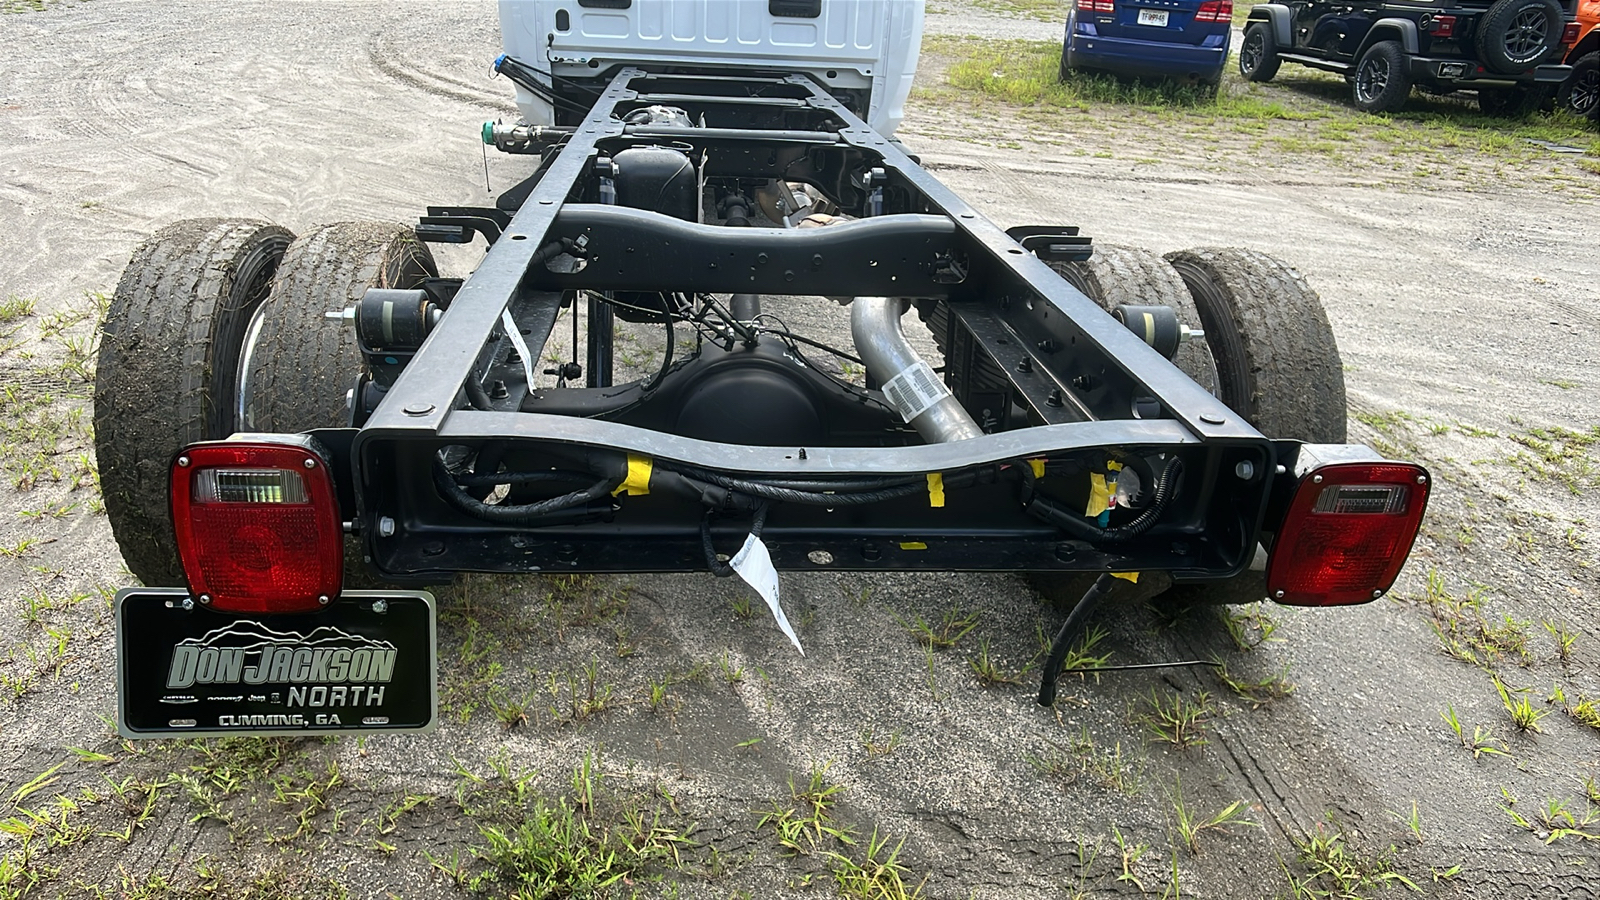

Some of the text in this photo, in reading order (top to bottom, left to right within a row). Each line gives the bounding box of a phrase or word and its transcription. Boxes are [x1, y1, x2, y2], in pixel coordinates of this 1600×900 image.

[166, 642, 398, 689] DON JACKSON
[287, 686, 385, 708] NORTH
[218, 713, 342, 728] CUMMING, GA
